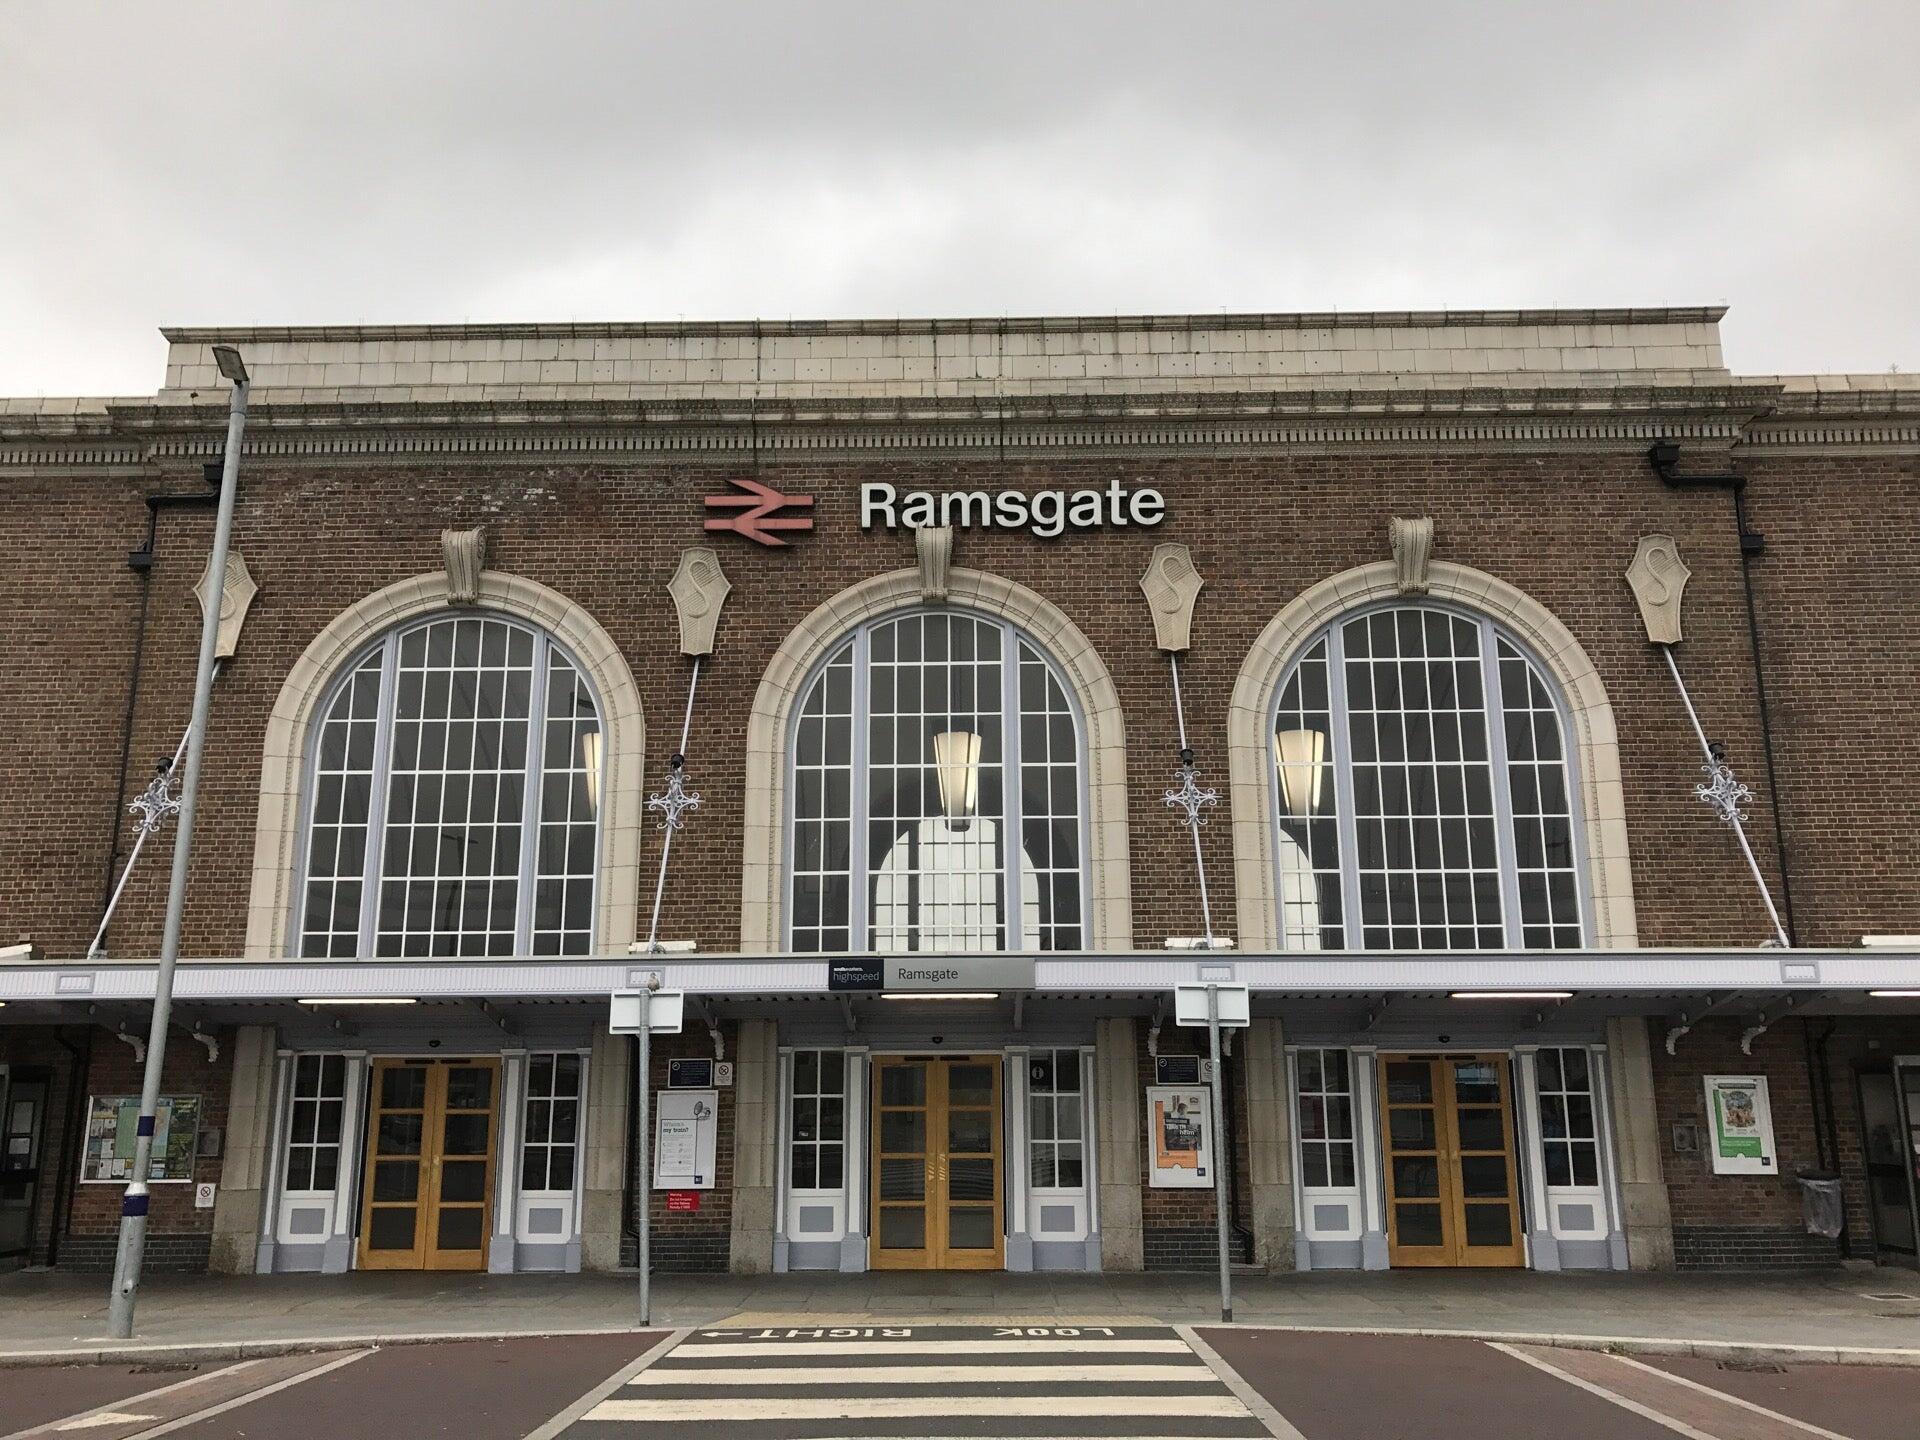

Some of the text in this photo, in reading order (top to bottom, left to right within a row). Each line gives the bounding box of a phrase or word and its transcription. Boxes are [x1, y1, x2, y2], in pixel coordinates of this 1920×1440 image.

[861, 479, 1165, 537] Ramsgate
[833, 972, 880, 983] highspeed
[898, 968, 959, 982] Ramsgate
[748, 1328, 1115, 1338] LOOK RIGHT
